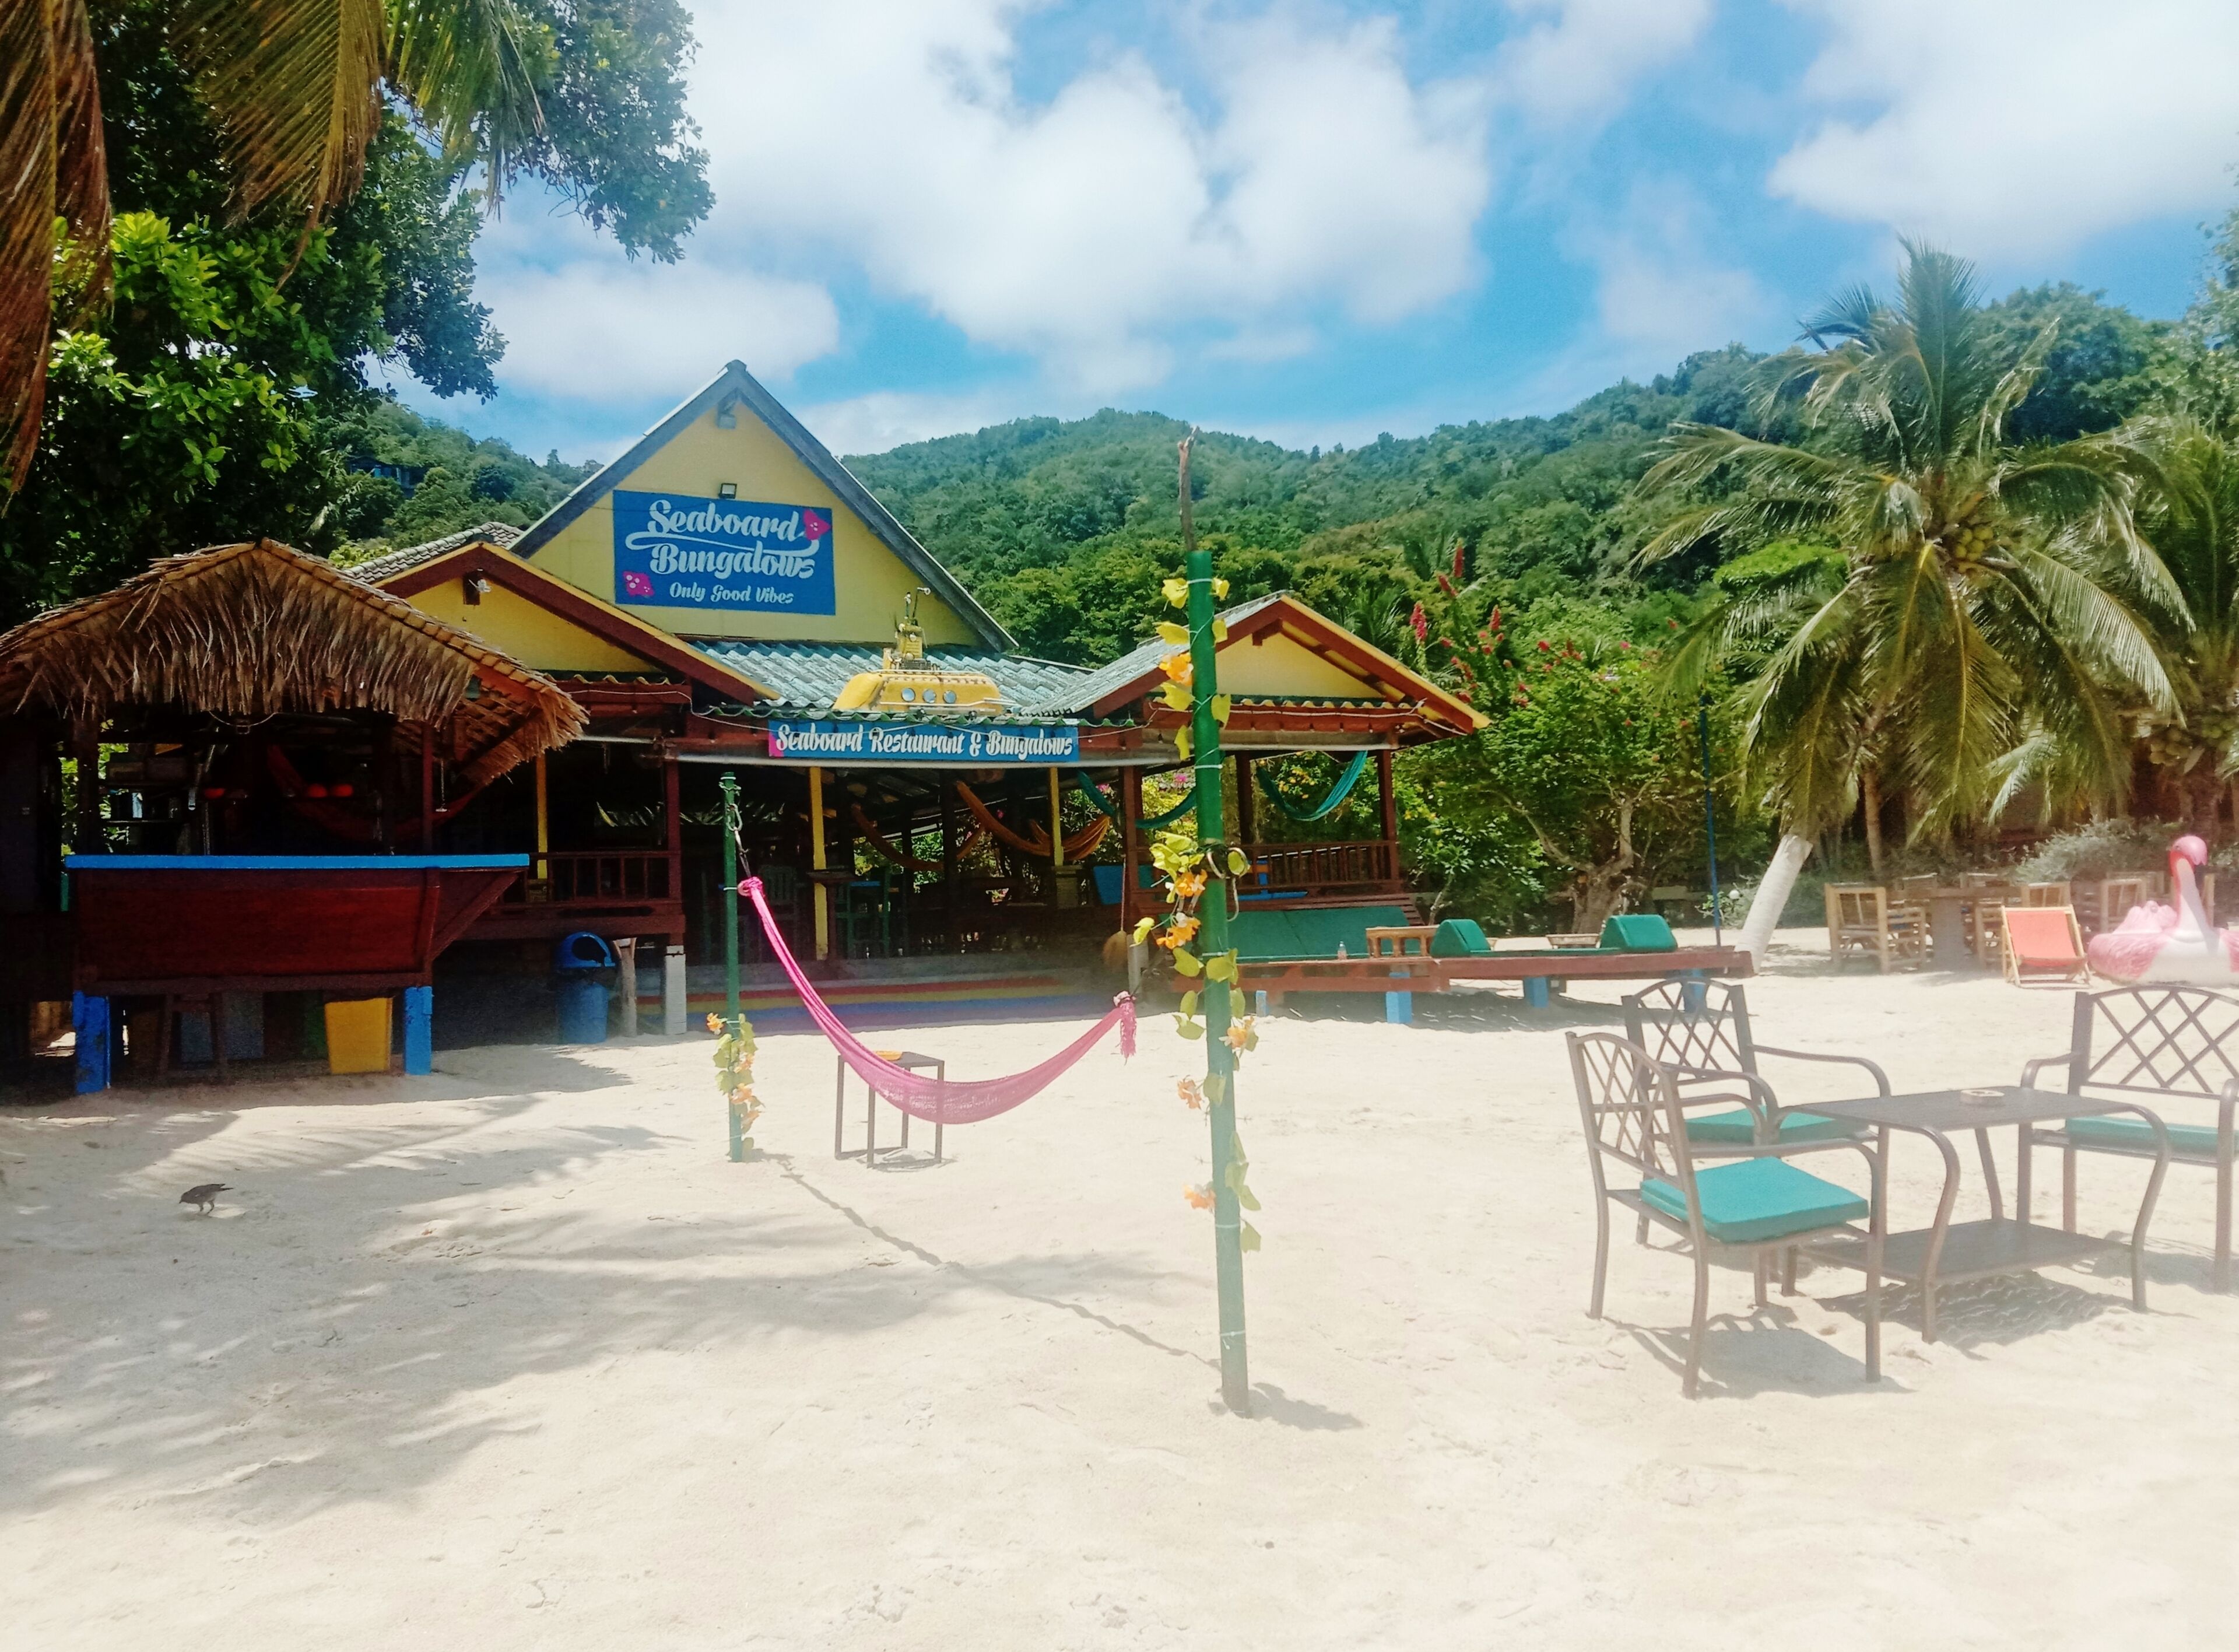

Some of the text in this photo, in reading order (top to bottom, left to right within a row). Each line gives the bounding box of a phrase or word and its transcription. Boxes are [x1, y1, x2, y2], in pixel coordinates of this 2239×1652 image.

[647, 499, 806, 542] Seaboard
[650, 541, 815, 579] Bungalows
[669, 582, 794, 604] Only Good Vibes
[776, 722, 1073, 760] Seaboard Restaurant & Bungalows
